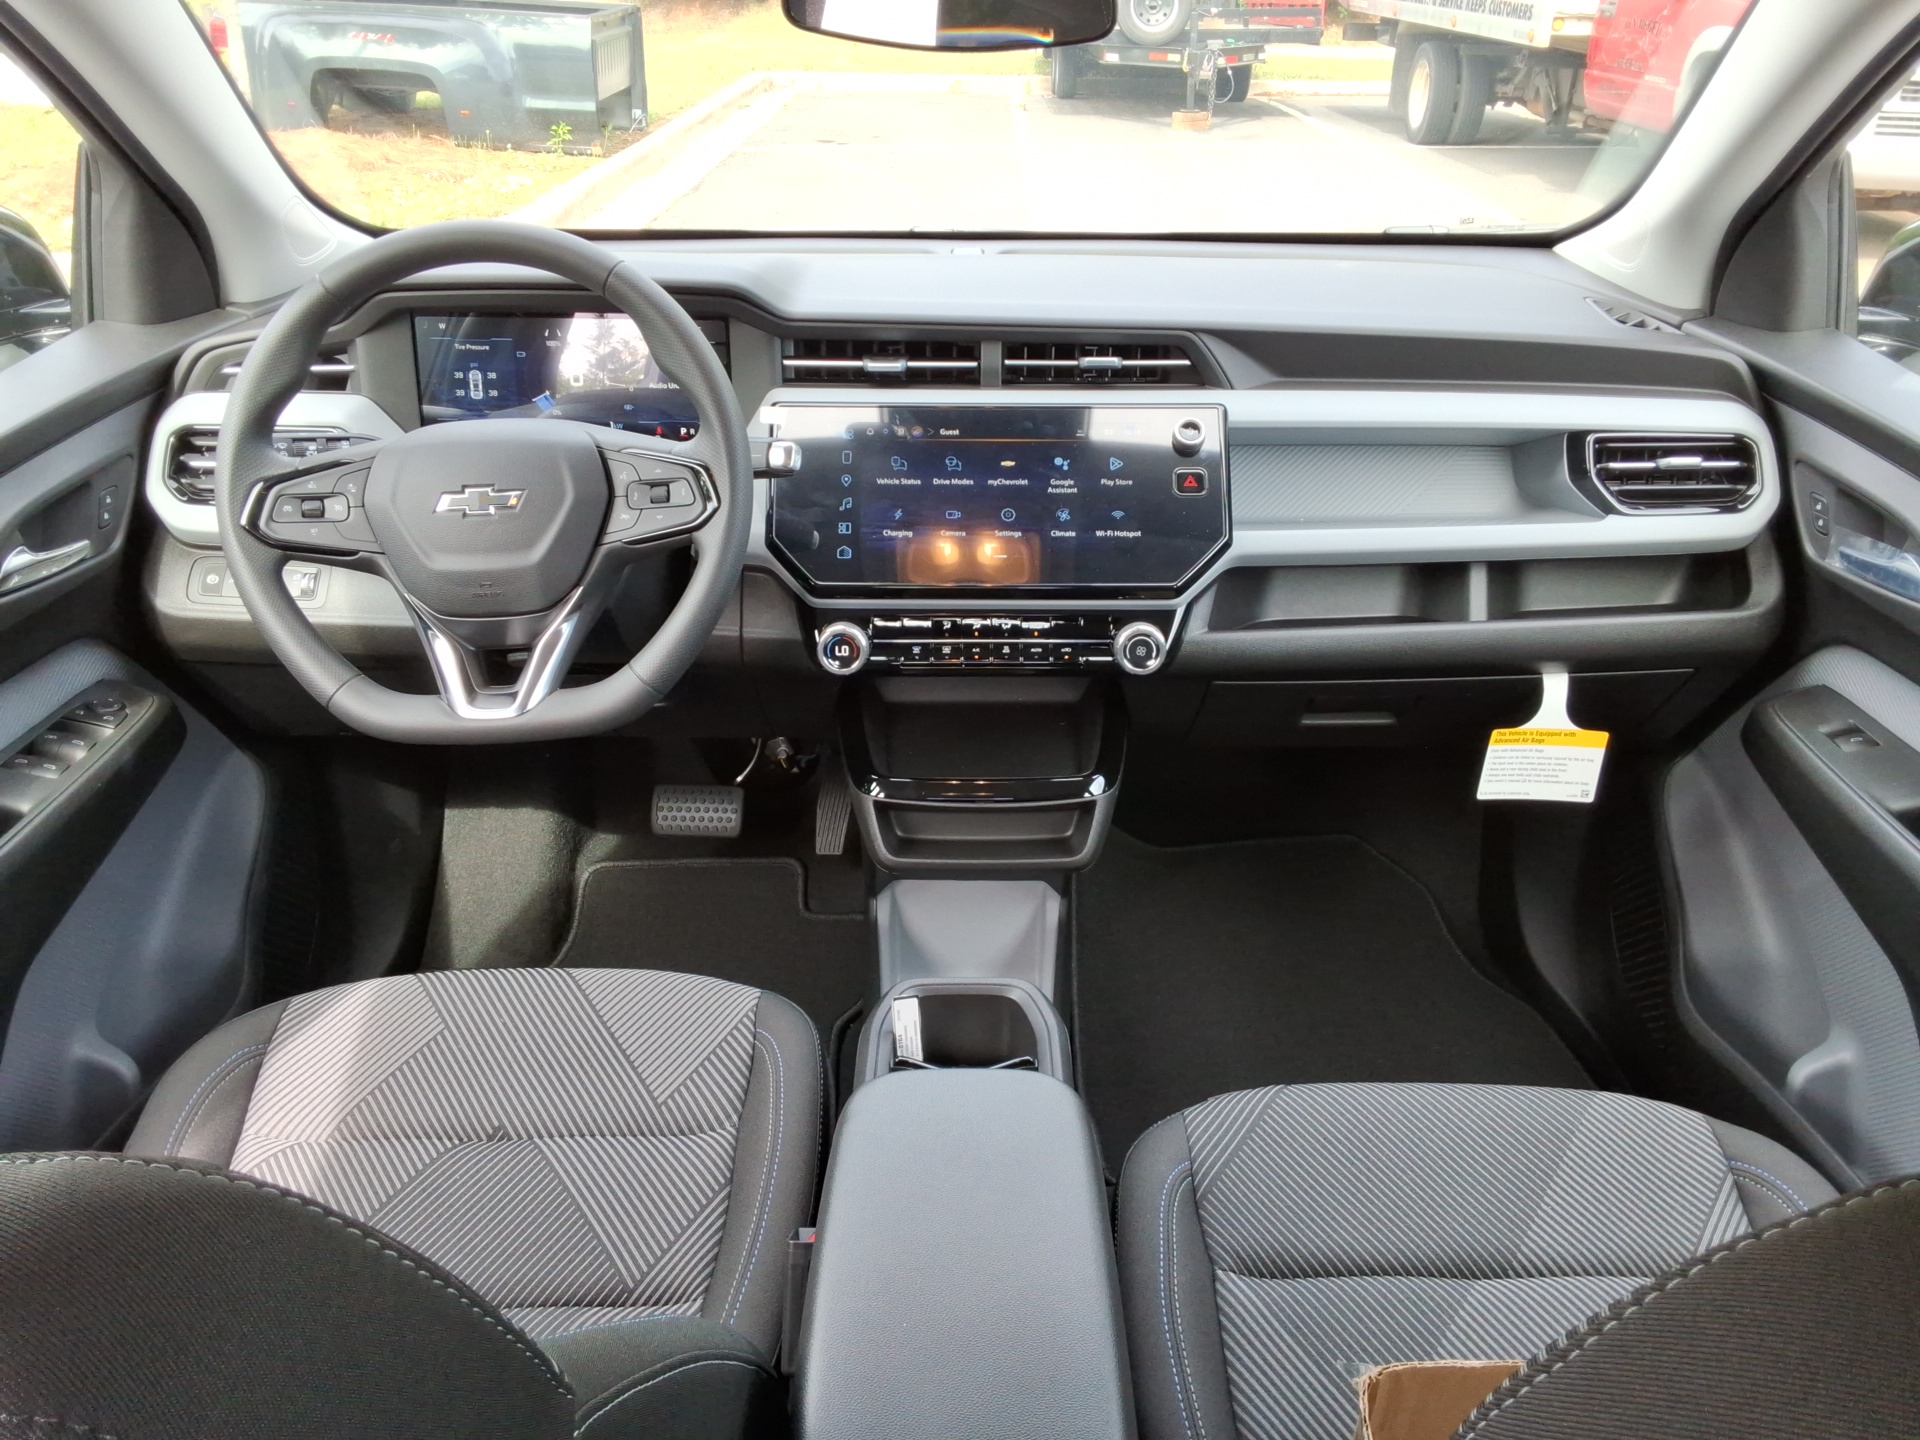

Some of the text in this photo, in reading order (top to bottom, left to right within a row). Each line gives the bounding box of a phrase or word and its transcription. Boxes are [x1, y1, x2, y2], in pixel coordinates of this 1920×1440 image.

[1465, 0, 1487, 14] KEEPS
[1488, 0, 1534, 21] CUSTOMERS
[453, 371, 464, 379] 39
[680, 427, 687, 435] P
[939, 428, 960, 436] Guest
[988, 478, 1028, 487] myChevrolet
[1050, 478, 1075, 487] Google
[1101, 478, 1133, 487] Play Store
[883, 529, 913, 538] Charging
[994, 530, 1022, 538] Settings
[1114, 530, 1142, 538] Hotspot
[835, 645, 849, 656] LO
